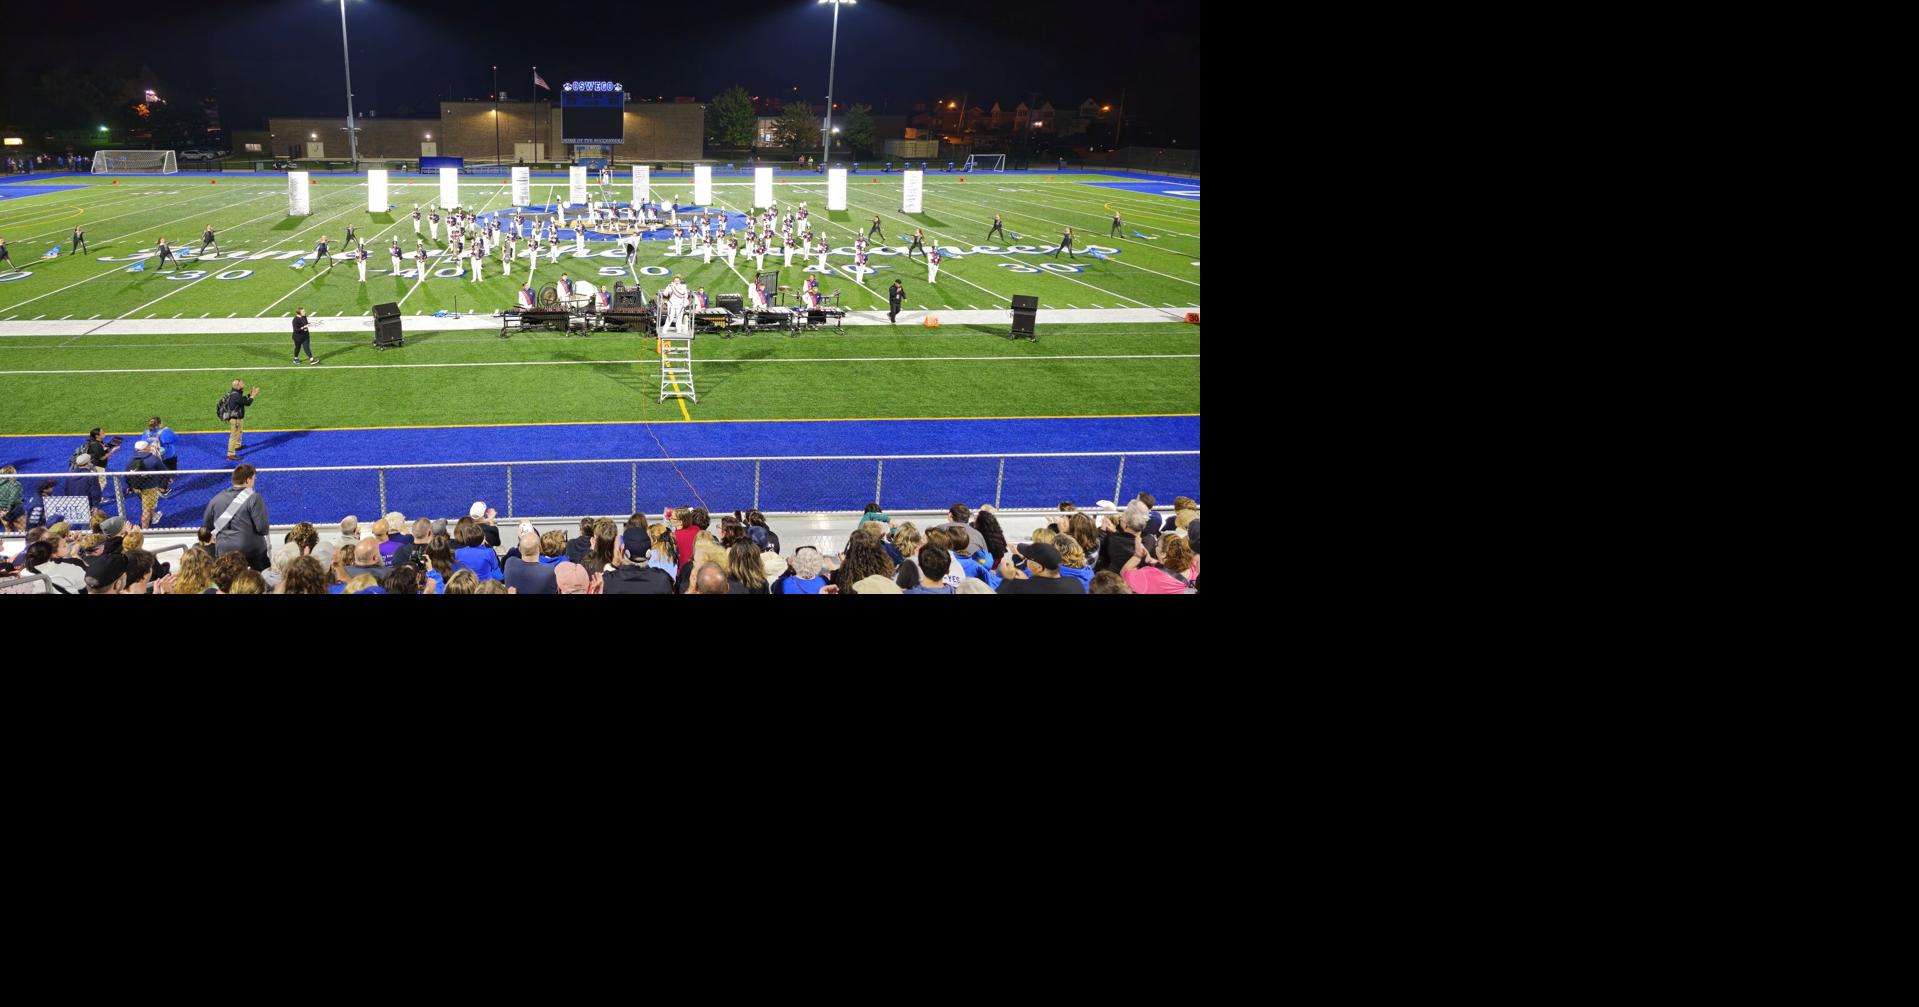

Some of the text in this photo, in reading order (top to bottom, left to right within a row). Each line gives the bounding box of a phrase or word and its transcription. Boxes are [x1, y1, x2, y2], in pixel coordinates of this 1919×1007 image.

[572, 81, 613, 91] OSWEGO
[166, 269, 255, 281] 30
[599, 265, 673, 277] 50
